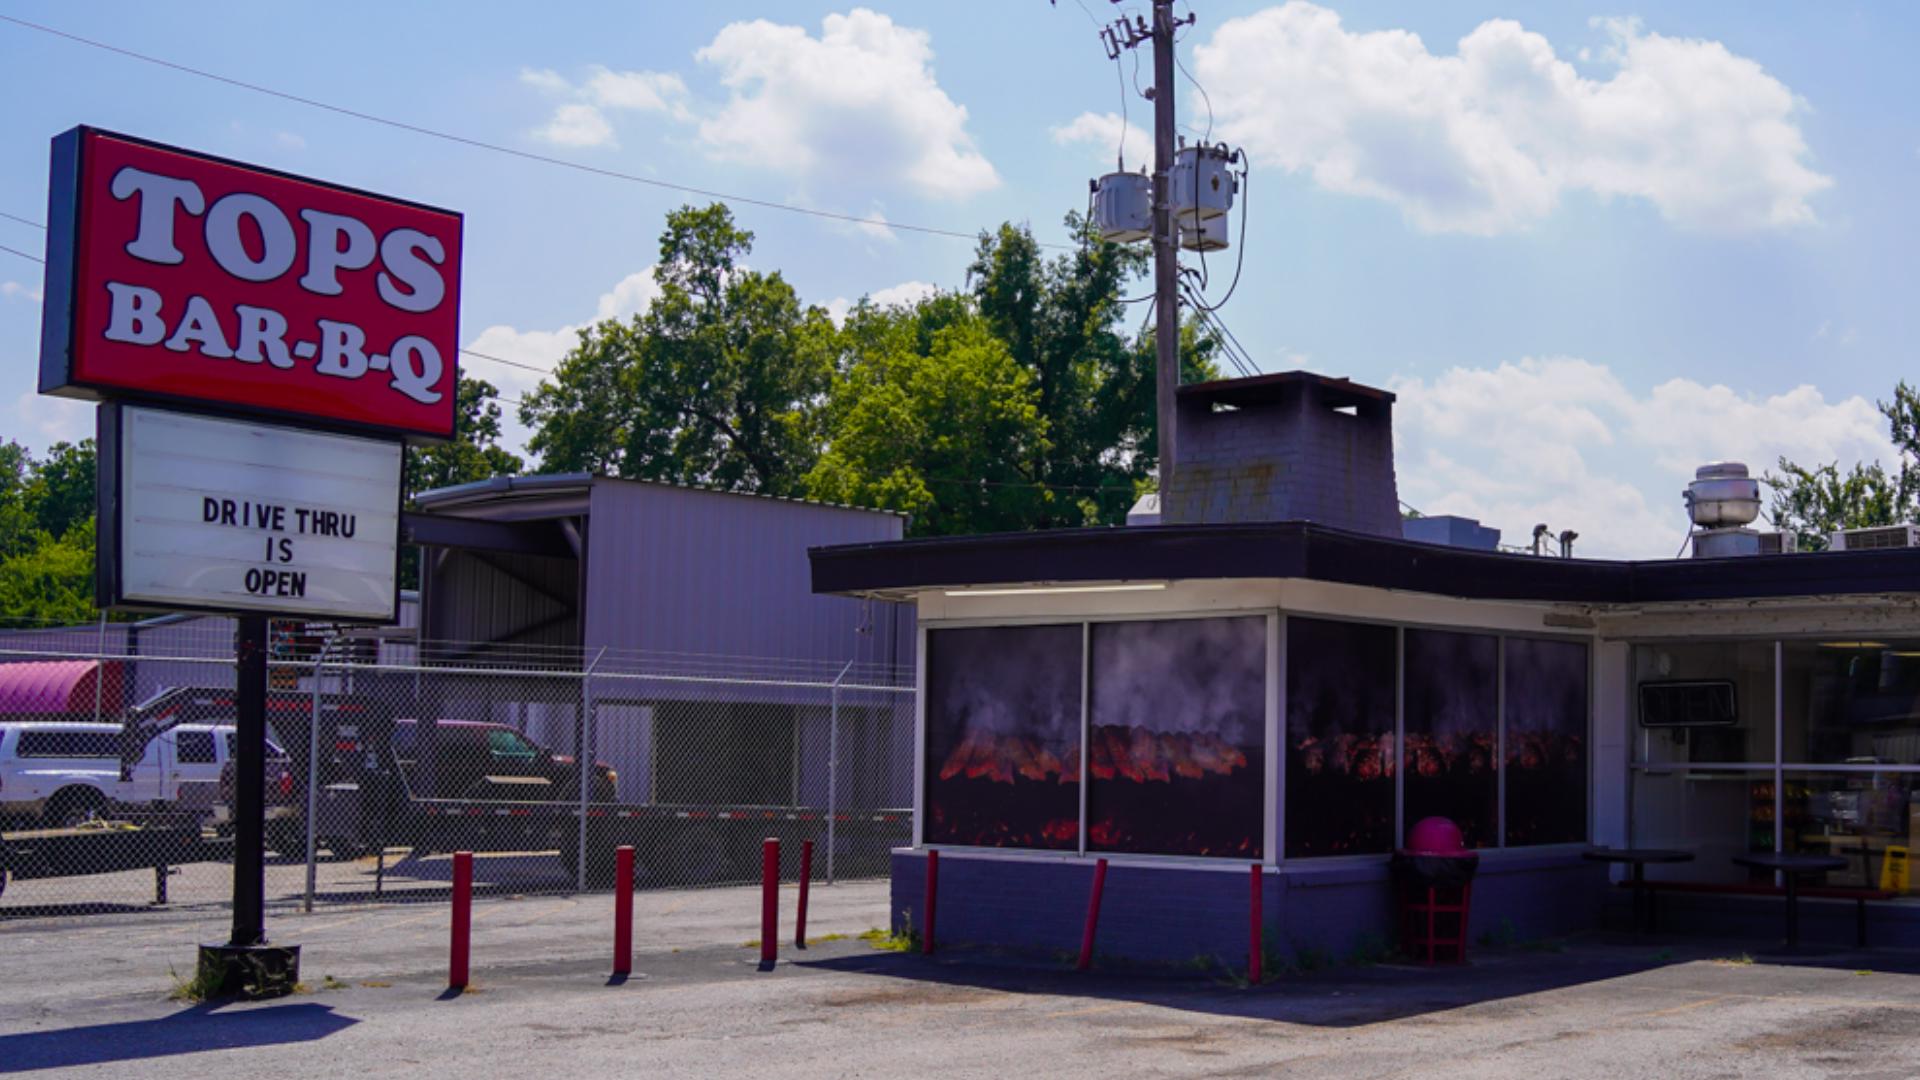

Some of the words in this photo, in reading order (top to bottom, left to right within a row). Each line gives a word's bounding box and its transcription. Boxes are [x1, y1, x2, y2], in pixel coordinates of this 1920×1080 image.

[111, 166, 446, 313] TOPS
[104, 281, 443, 404] BAR-B-Q
[203, 497, 285, 531] DRIVE
[295, 508, 355, 538] THRU
[266, 537, 293, 562] IS
[245, 568, 306, 597] OPEN
